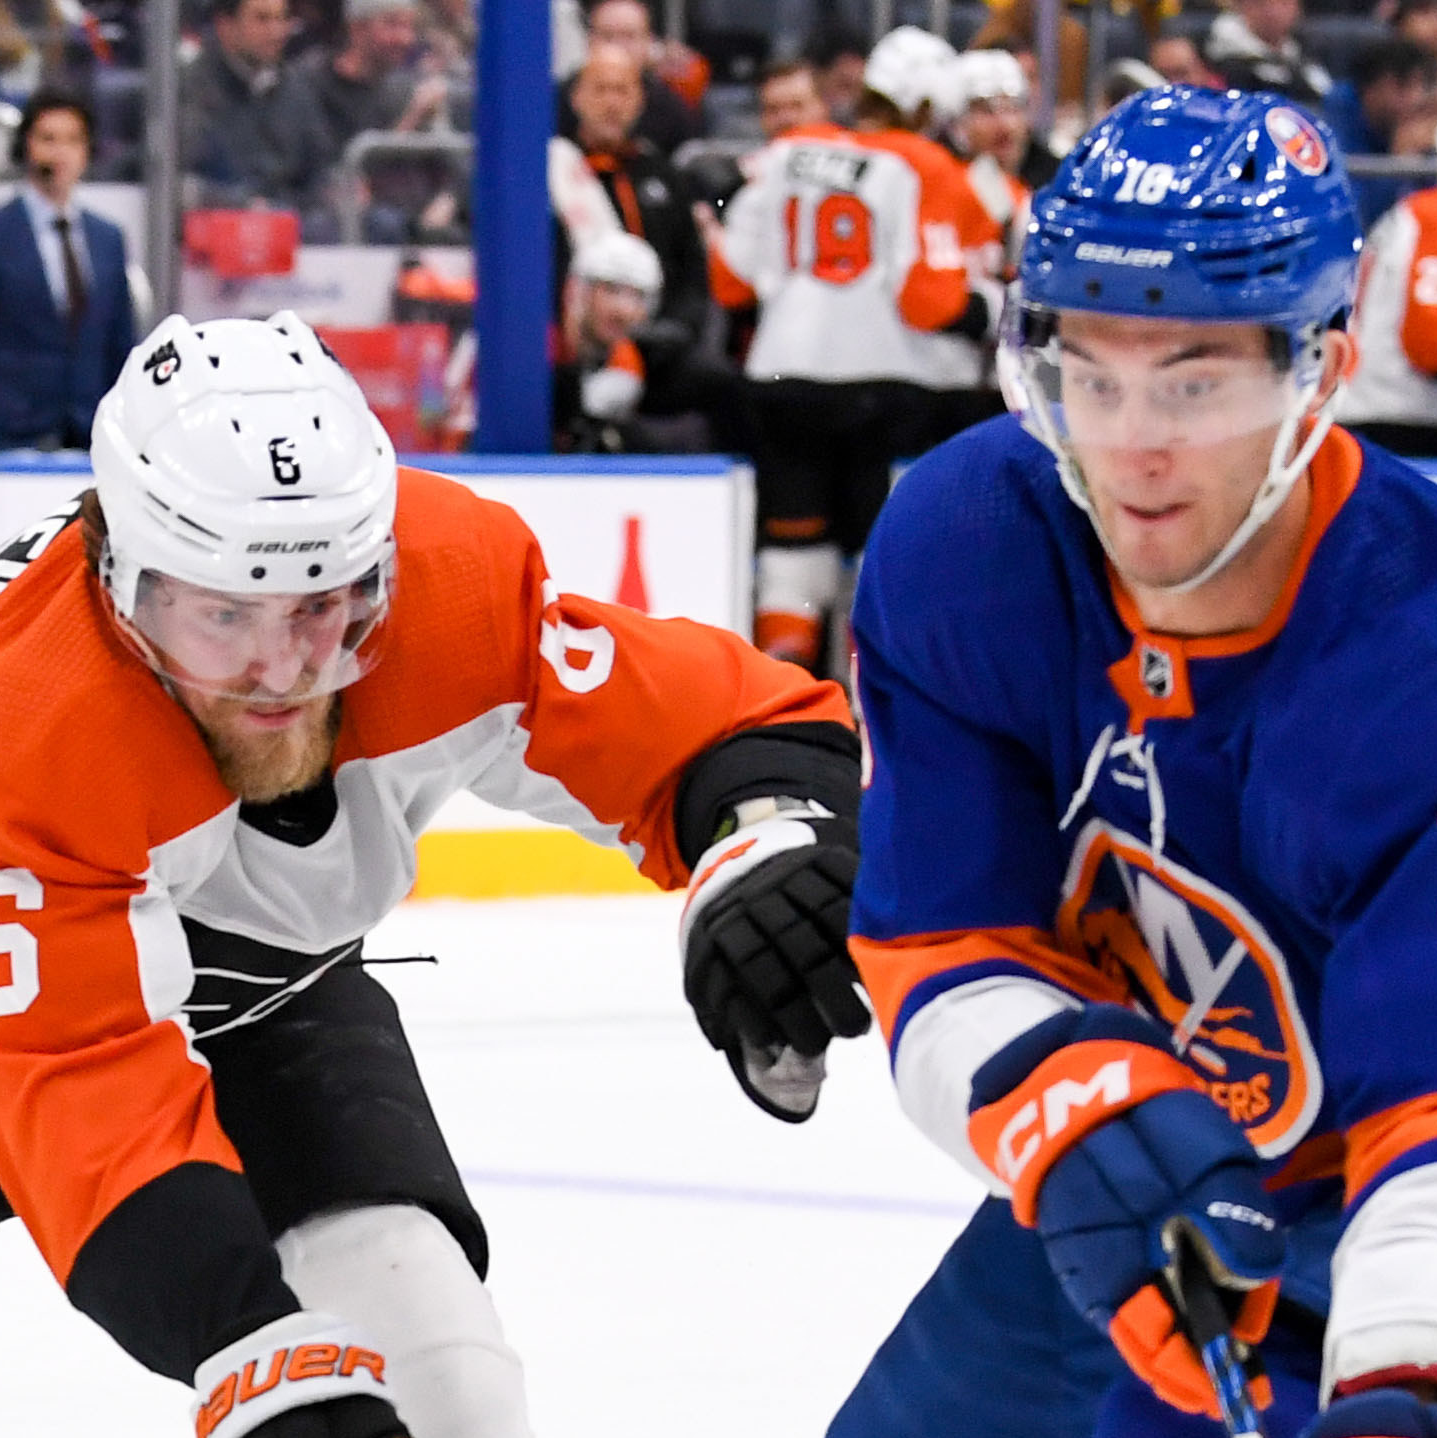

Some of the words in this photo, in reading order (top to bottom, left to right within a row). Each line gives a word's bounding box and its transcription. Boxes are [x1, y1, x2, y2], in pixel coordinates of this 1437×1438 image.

[1074, 241, 1174, 269] BAUER
[268, 436, 301, 486] 6
[245, 540, 331, 554] BAUER
